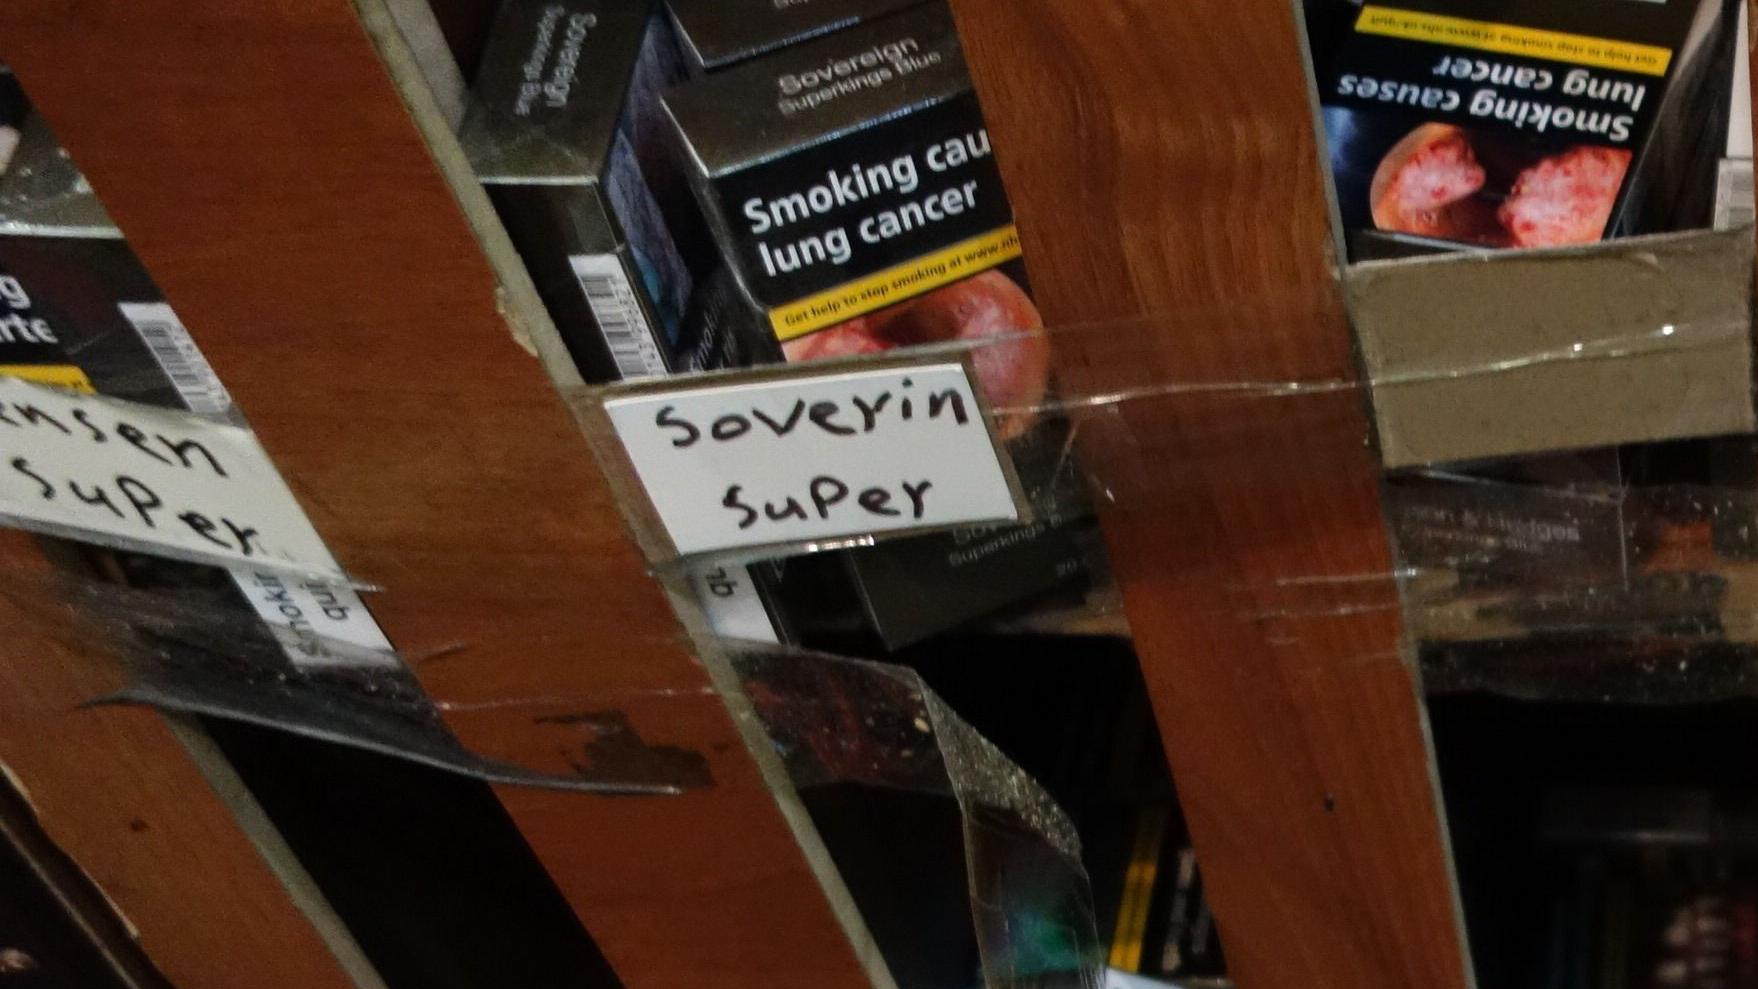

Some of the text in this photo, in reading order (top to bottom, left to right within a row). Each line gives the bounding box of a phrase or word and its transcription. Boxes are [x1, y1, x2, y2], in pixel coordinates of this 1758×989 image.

[778, 37, 919, 95] Sovereign
[1431, 55, 1647, 113] lung cancer
[1337, 74, 1634, 142] Smoking causes
[743, 129, 992, 235] Smoking cau
[759, 179, 978, 277] lung cancer
[811, 300, 842, 318] help
[860, 284, 889, 302] stop
[892, 265, 947, 290] smoking
